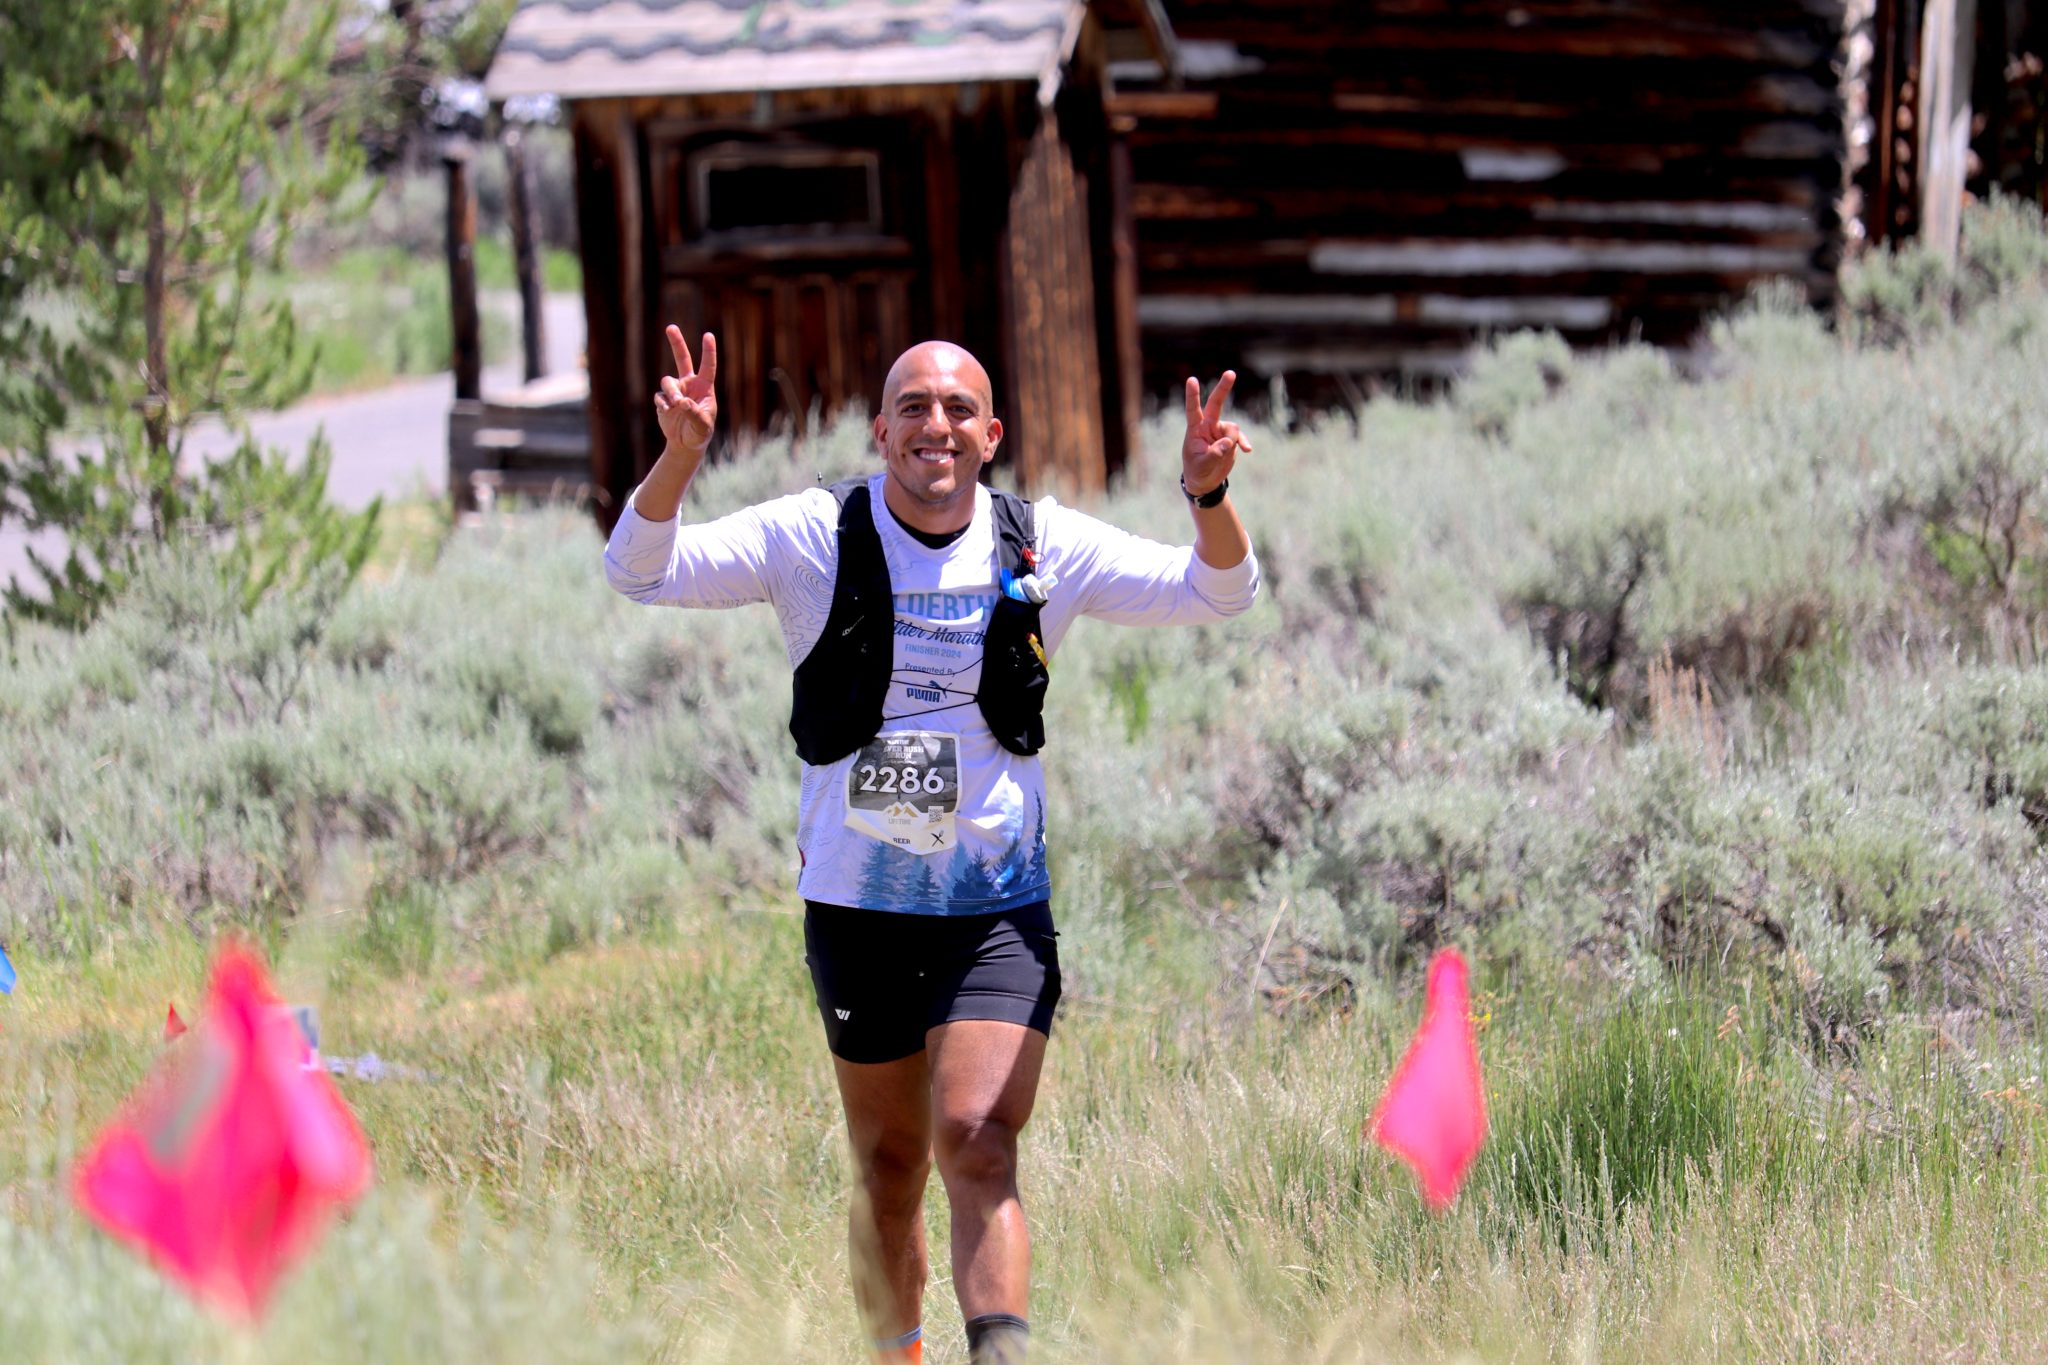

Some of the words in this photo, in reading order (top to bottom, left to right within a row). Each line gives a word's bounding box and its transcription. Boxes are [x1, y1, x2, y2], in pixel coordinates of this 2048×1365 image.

[892, 592, 995, 621] LDERTH
[893, 619, 926, 639] lder
[927, 627, 985, 646] Marath
[905, 643, 940, 656] FINISHER
[941, 648, 962, 658] 2024
[905, 662, 945, 674] Presented
[906, 687, 941, 703] PUMA
[860, 764, 945, 795] 2286
